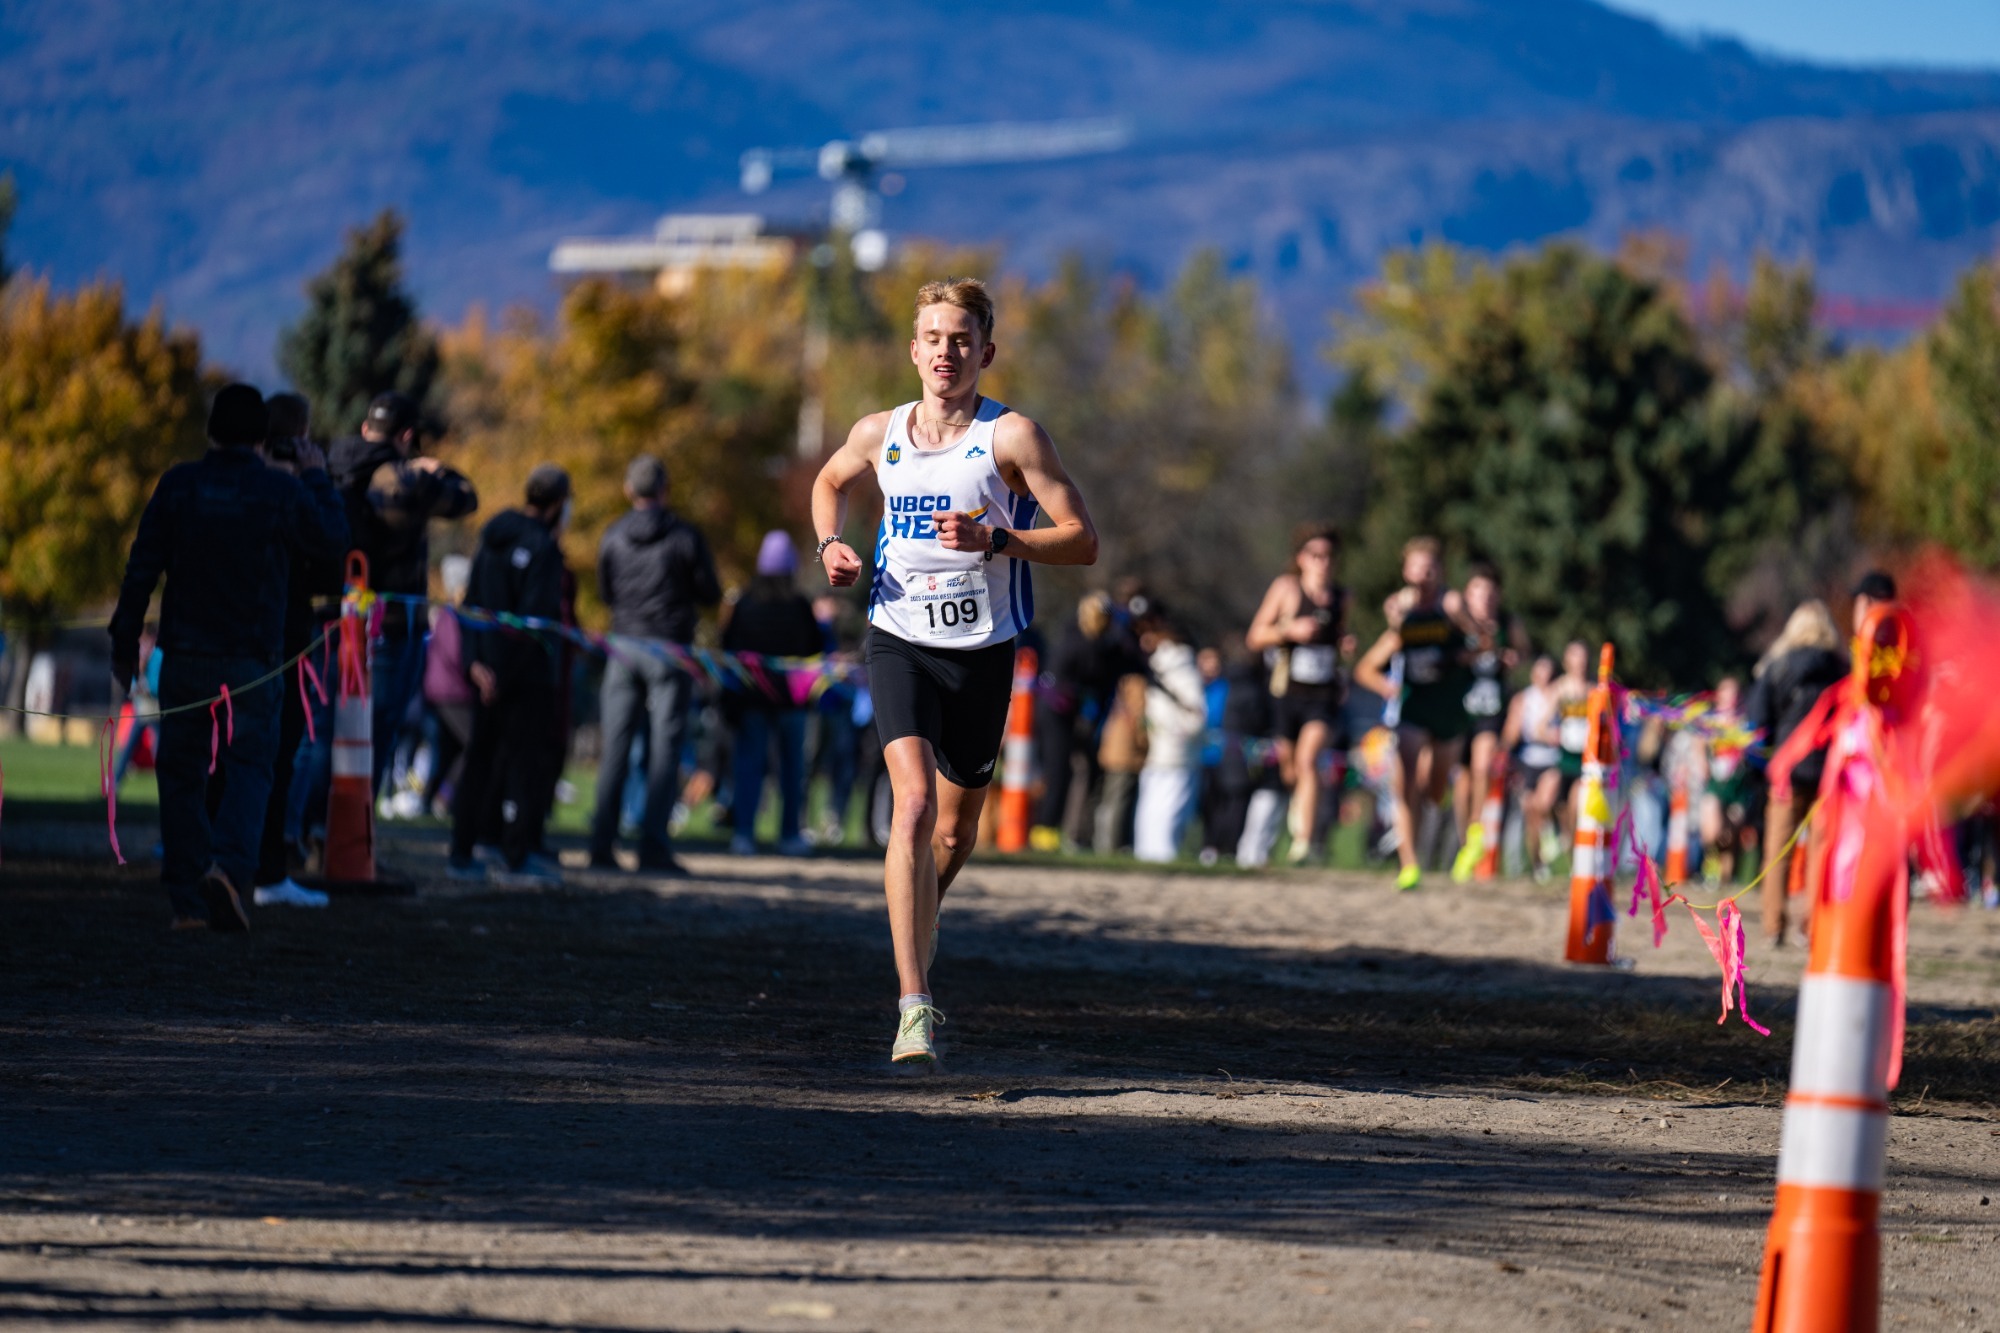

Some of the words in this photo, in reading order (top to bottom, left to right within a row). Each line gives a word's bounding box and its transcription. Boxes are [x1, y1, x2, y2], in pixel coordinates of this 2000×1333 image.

[887, 449, 900, 461] CW
[890, 495, 951, 512] UBCO
[891, 514, 938, 539] HE
[952, 588, 986, 599] CHAMPIONSHIP
[924, 599, 978, 628] 109
